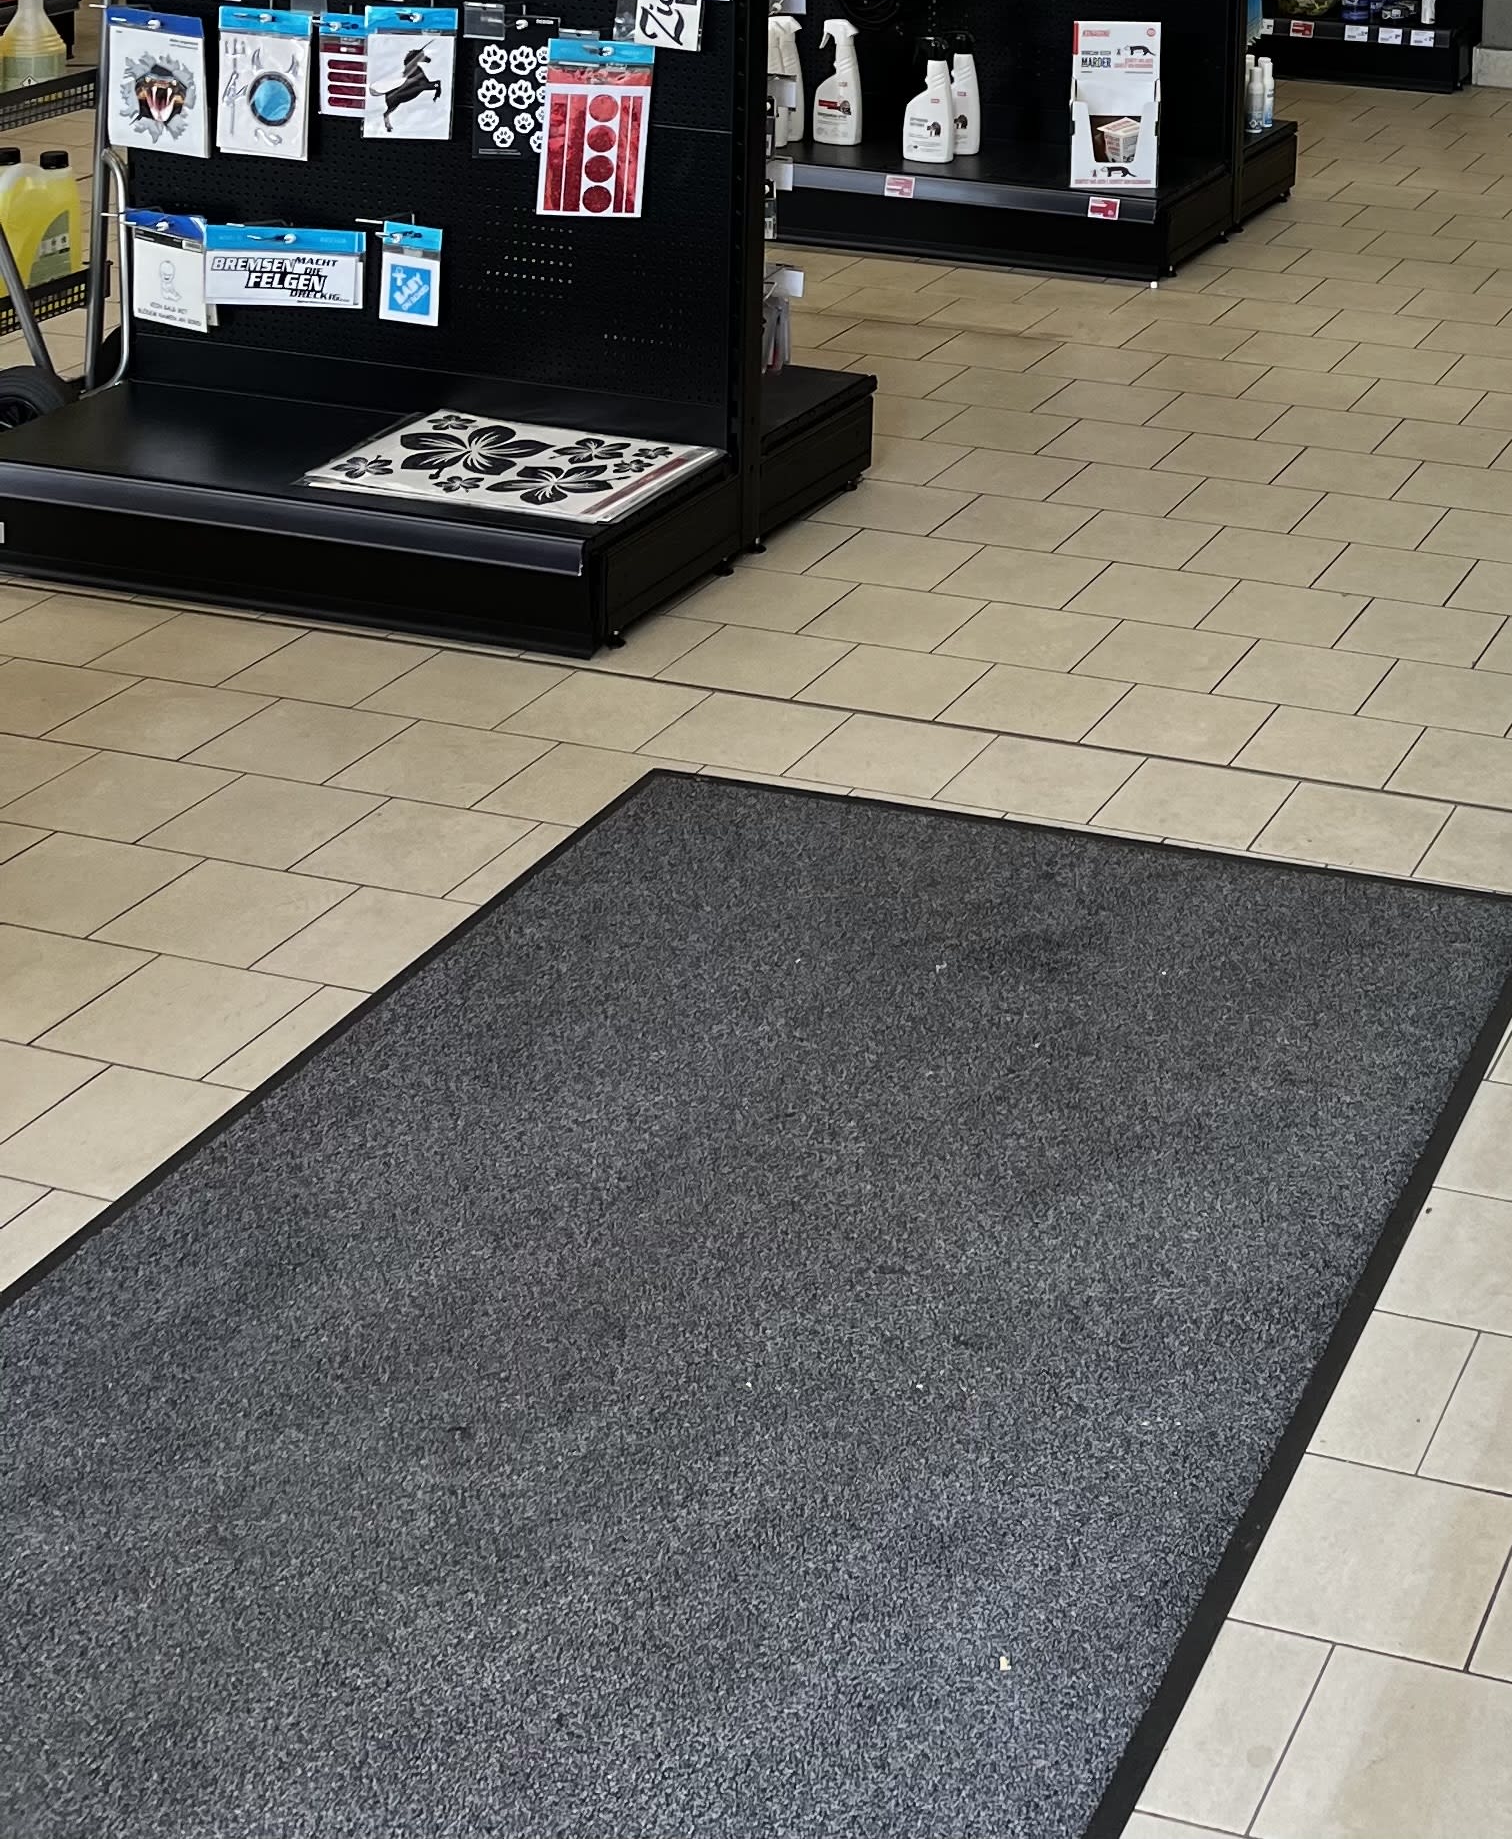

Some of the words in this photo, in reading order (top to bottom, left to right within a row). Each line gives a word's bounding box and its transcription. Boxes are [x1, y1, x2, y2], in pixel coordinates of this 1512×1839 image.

[211, 257, 296, 273] BREMSEN
[296, 257, 338, 267] MACHT
[245, 273, 328, 291] FELGEN
